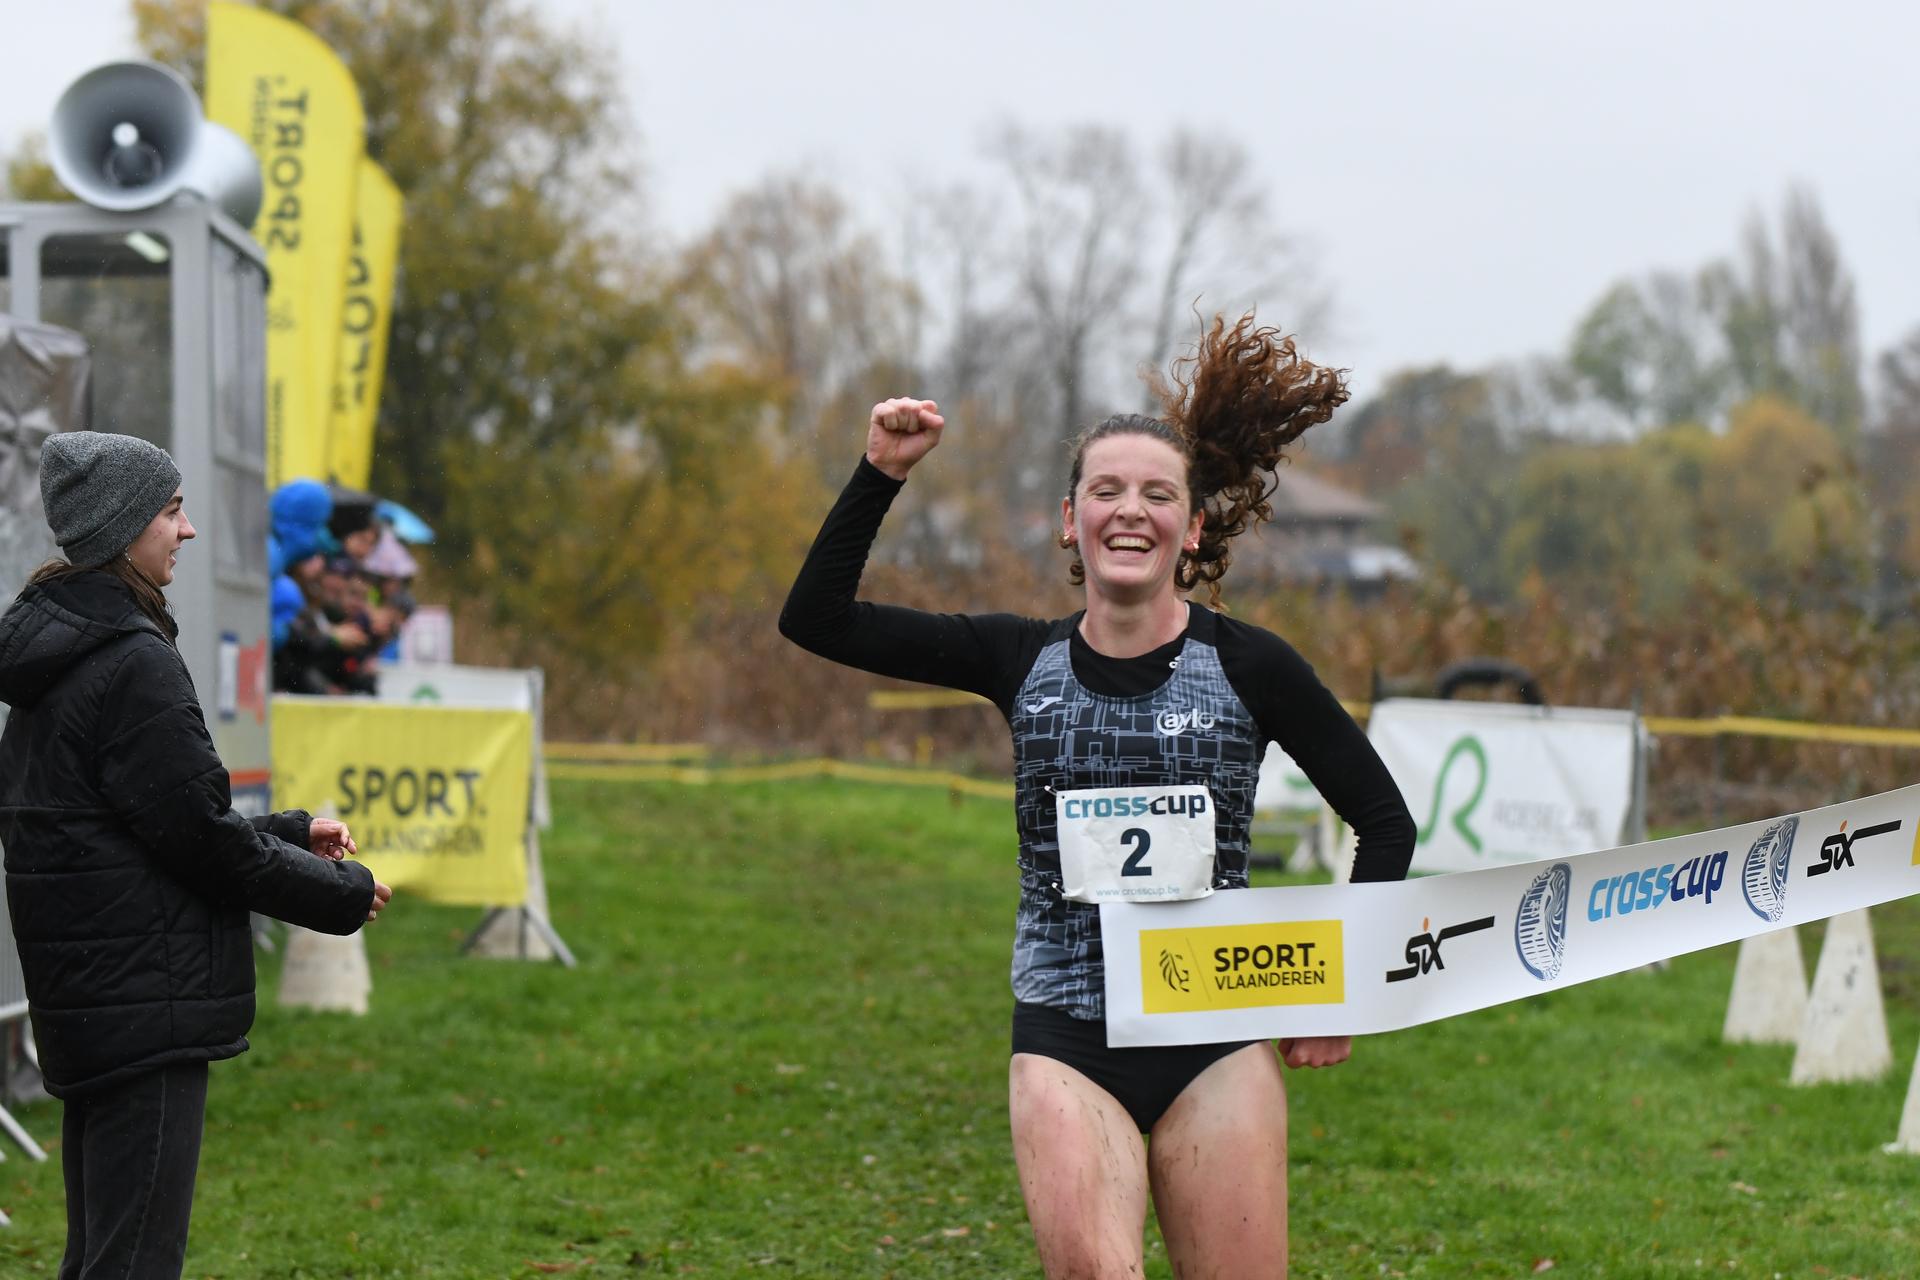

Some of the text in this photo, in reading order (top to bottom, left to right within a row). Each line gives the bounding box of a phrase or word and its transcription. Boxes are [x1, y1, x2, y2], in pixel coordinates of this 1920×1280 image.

[338, 765, 487, 818] SPORT.
[1065, 794, 1206, 819] crosscup
[1120, 827, 1152, 877] 2
[1096, 886, 1180, 897] www.crosscup.be
[1587, 850, 1729, 922] crosscup
[1214, 943, 1325, 972] SPORT.
[1215, 970, 1325, 990] VLAANDEREN
